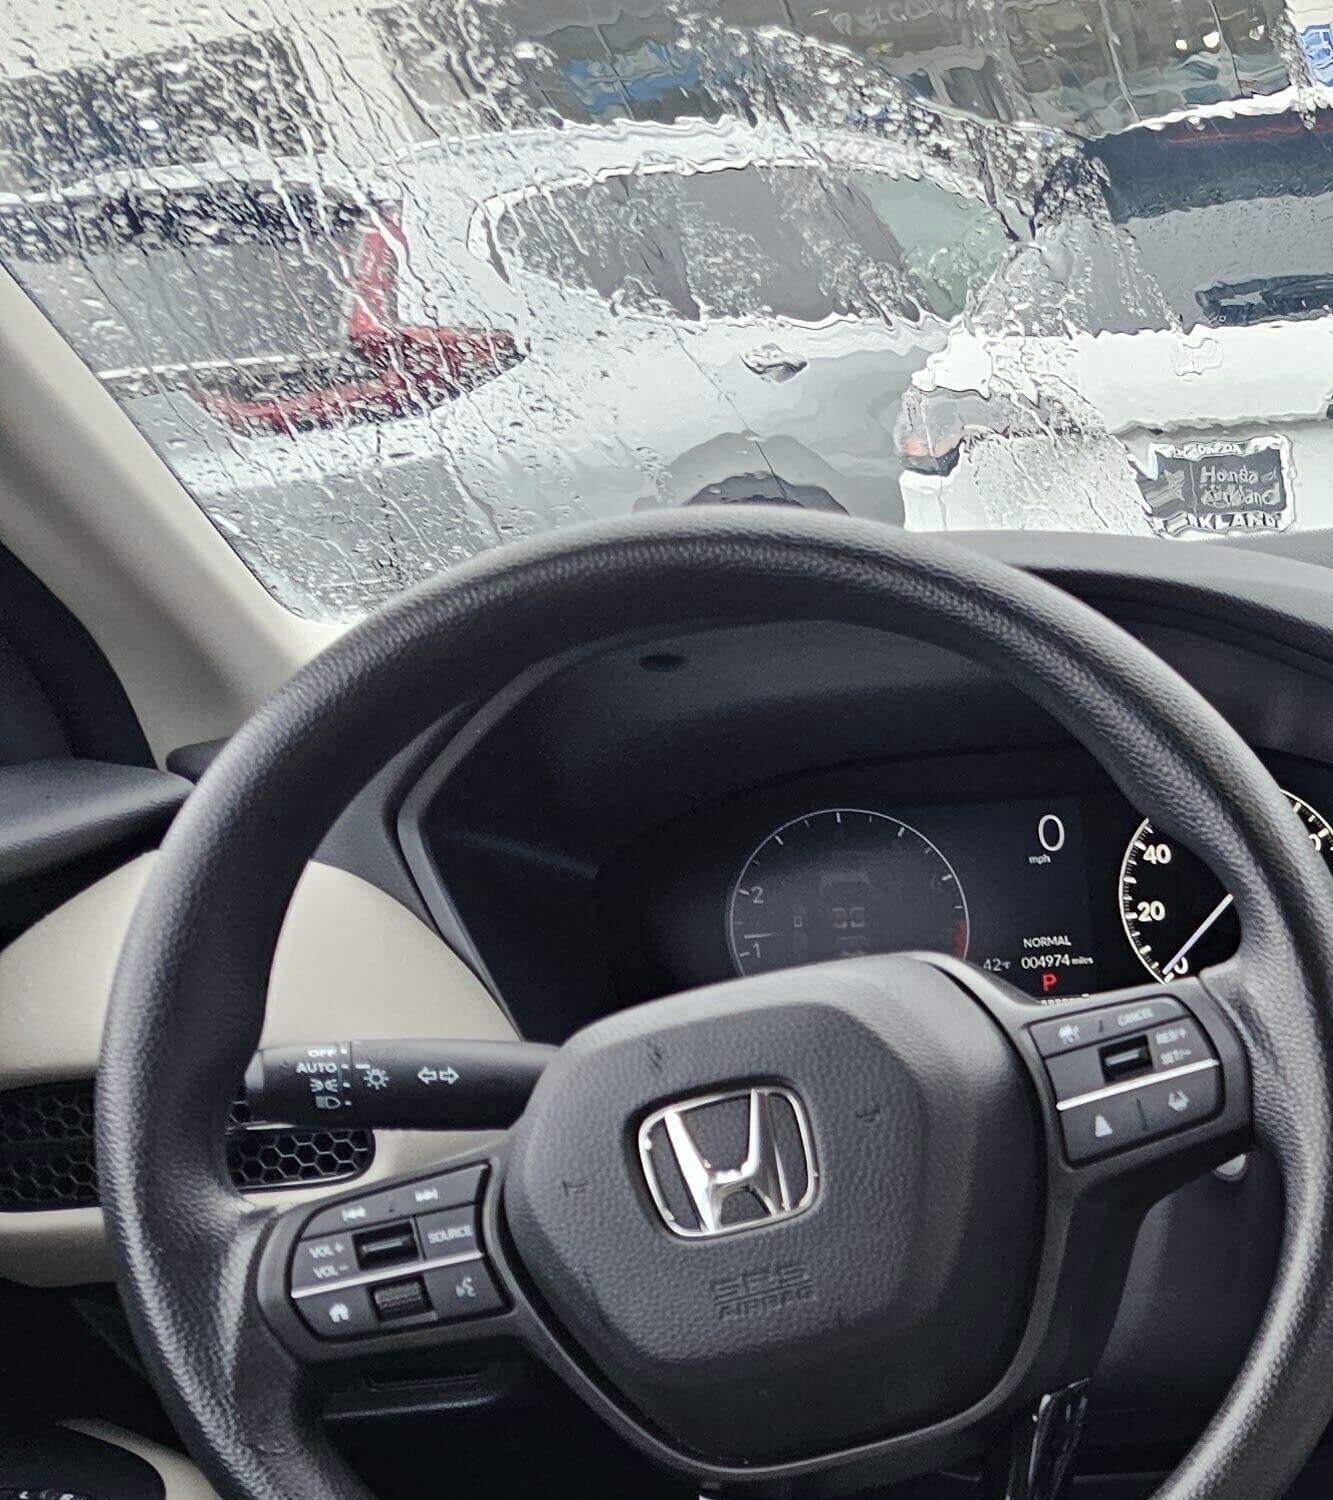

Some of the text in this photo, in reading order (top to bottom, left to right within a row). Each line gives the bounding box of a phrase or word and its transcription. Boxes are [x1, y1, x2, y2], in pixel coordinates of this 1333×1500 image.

[1036, 813, 1066, 852] 0
[1028, 852, 1051, 866] mph
[1143, 843, 1172, 865] 40
[751, 886, 764, 904] 2
[1137, 900, 1166, 921] 20
[1023, 935, 1072, 948] NORMAL
[1021, 954, 1071, 970] 004974
[1042, 974, 1058, 992] P
[308, 1047, 337, 1058] OFF
[296, 1062, 338, 1075] AUTO
